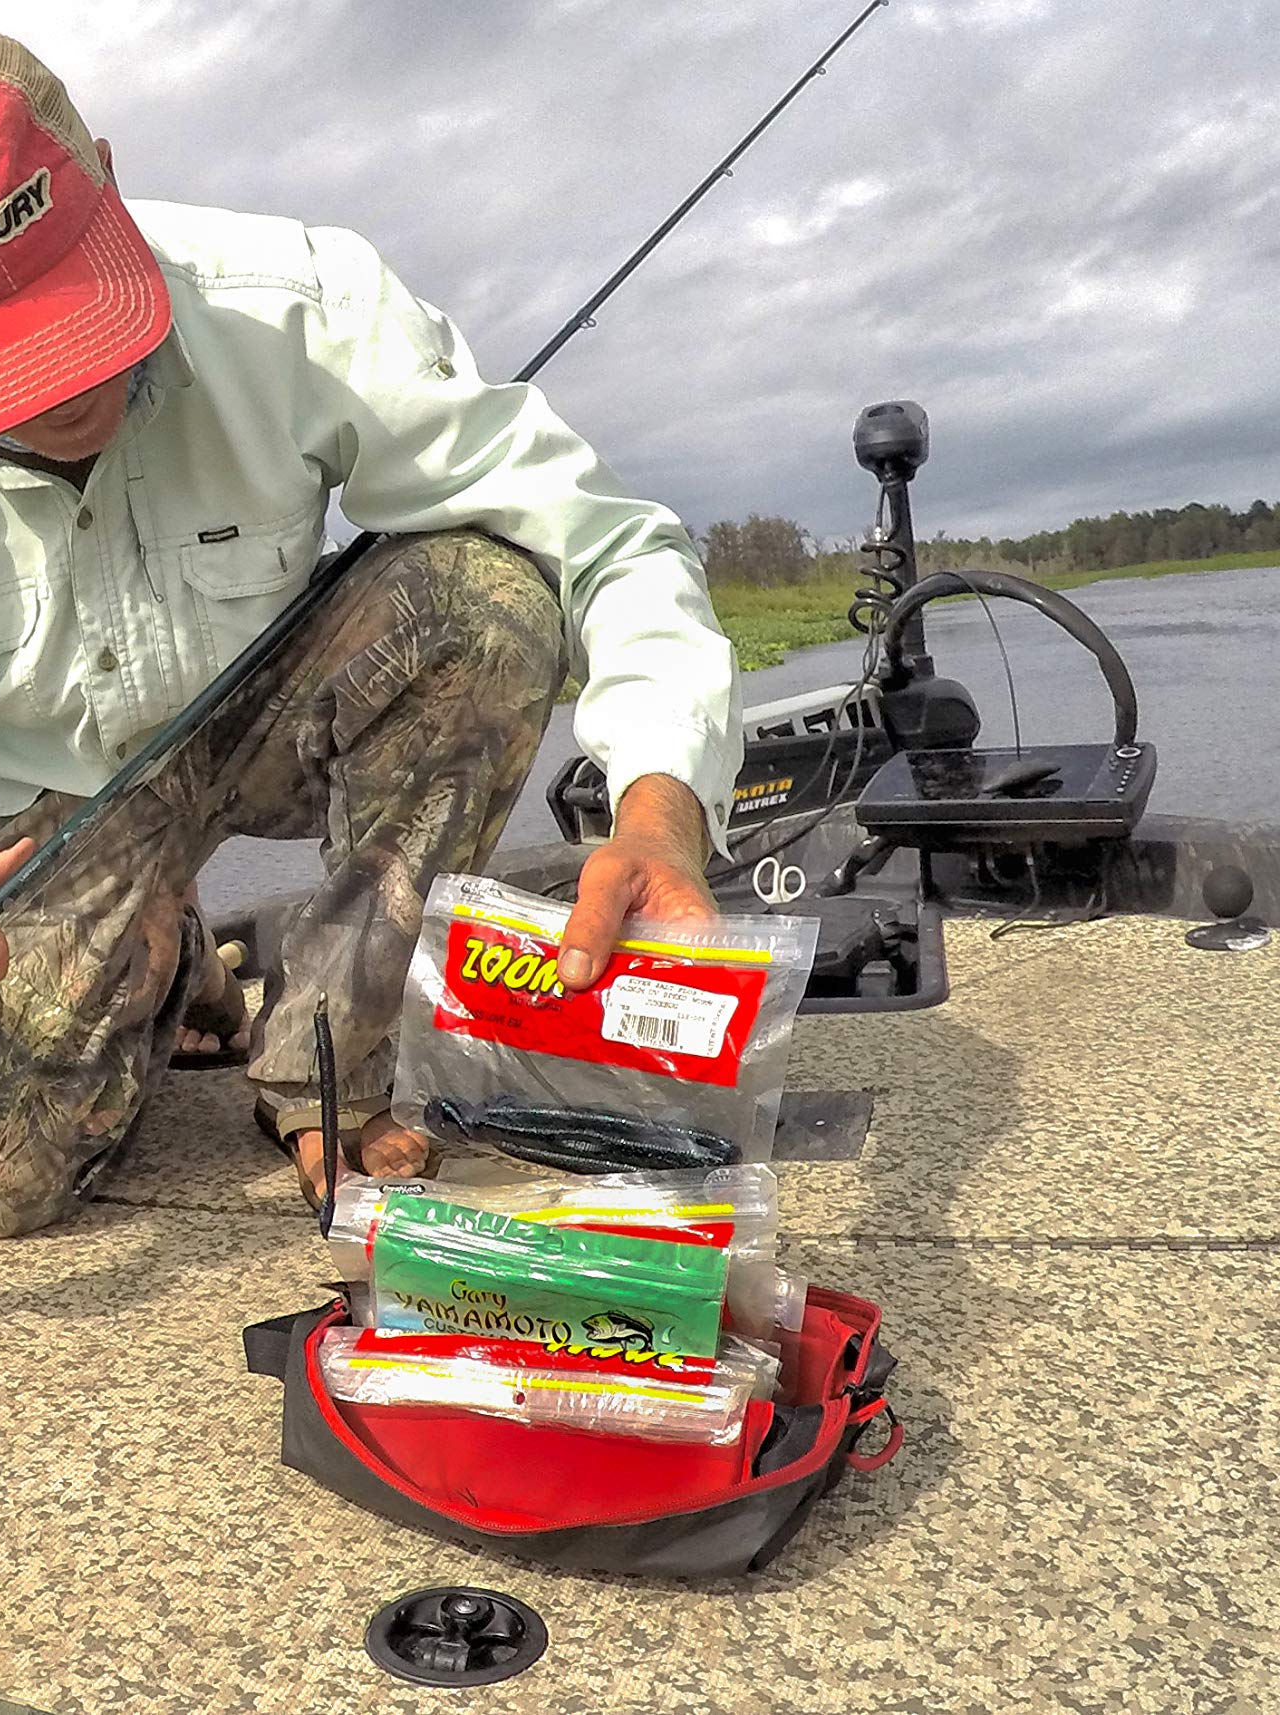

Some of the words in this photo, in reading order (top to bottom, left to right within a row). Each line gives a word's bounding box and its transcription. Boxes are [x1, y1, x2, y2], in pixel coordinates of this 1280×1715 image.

[733, 776, 794, 800] KOTA
[737, 793, 789, 813] ULTREX
[450, 1279, 508, 1311] Gary
[394, 1291, 572, 1345] YAMAMOTO
